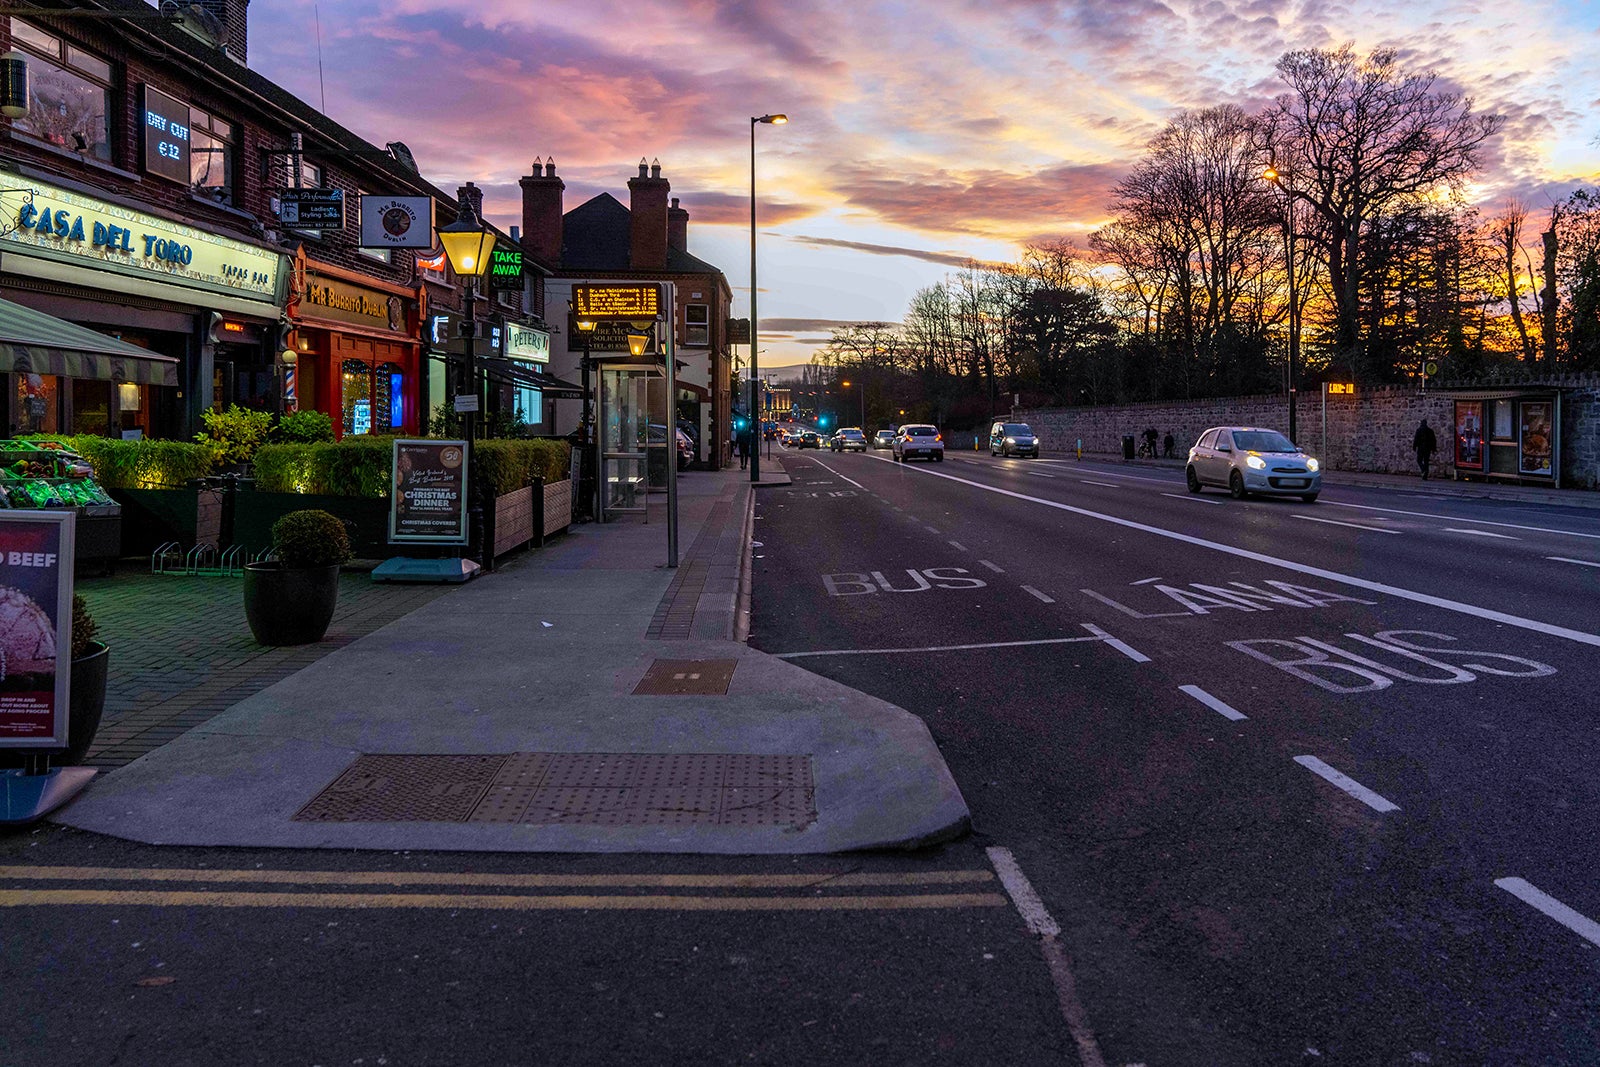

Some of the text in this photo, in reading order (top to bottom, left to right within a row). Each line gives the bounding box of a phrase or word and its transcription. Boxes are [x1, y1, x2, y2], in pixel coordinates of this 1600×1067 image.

[147, 111, 189, 141] DRY CUT
[158, 141, 180, 160] €12
[20, 202, 193, 266] CASA DEL TORO
[492, 250, 522, 264] TAKE
[222, 263, 269, 284] TAPAS BAR
[492, 264, 522, 276] AWAY
[513, 331, 542, 350] PETERS
[404, 491, 457, 500] CHRISTMAS
[413, 499, 450, 507] DINNER
[8, 552, 57, 568] BEEF
[821, 567, 988, 597] BUS
[1225, 629, 1558, 695] BUS
